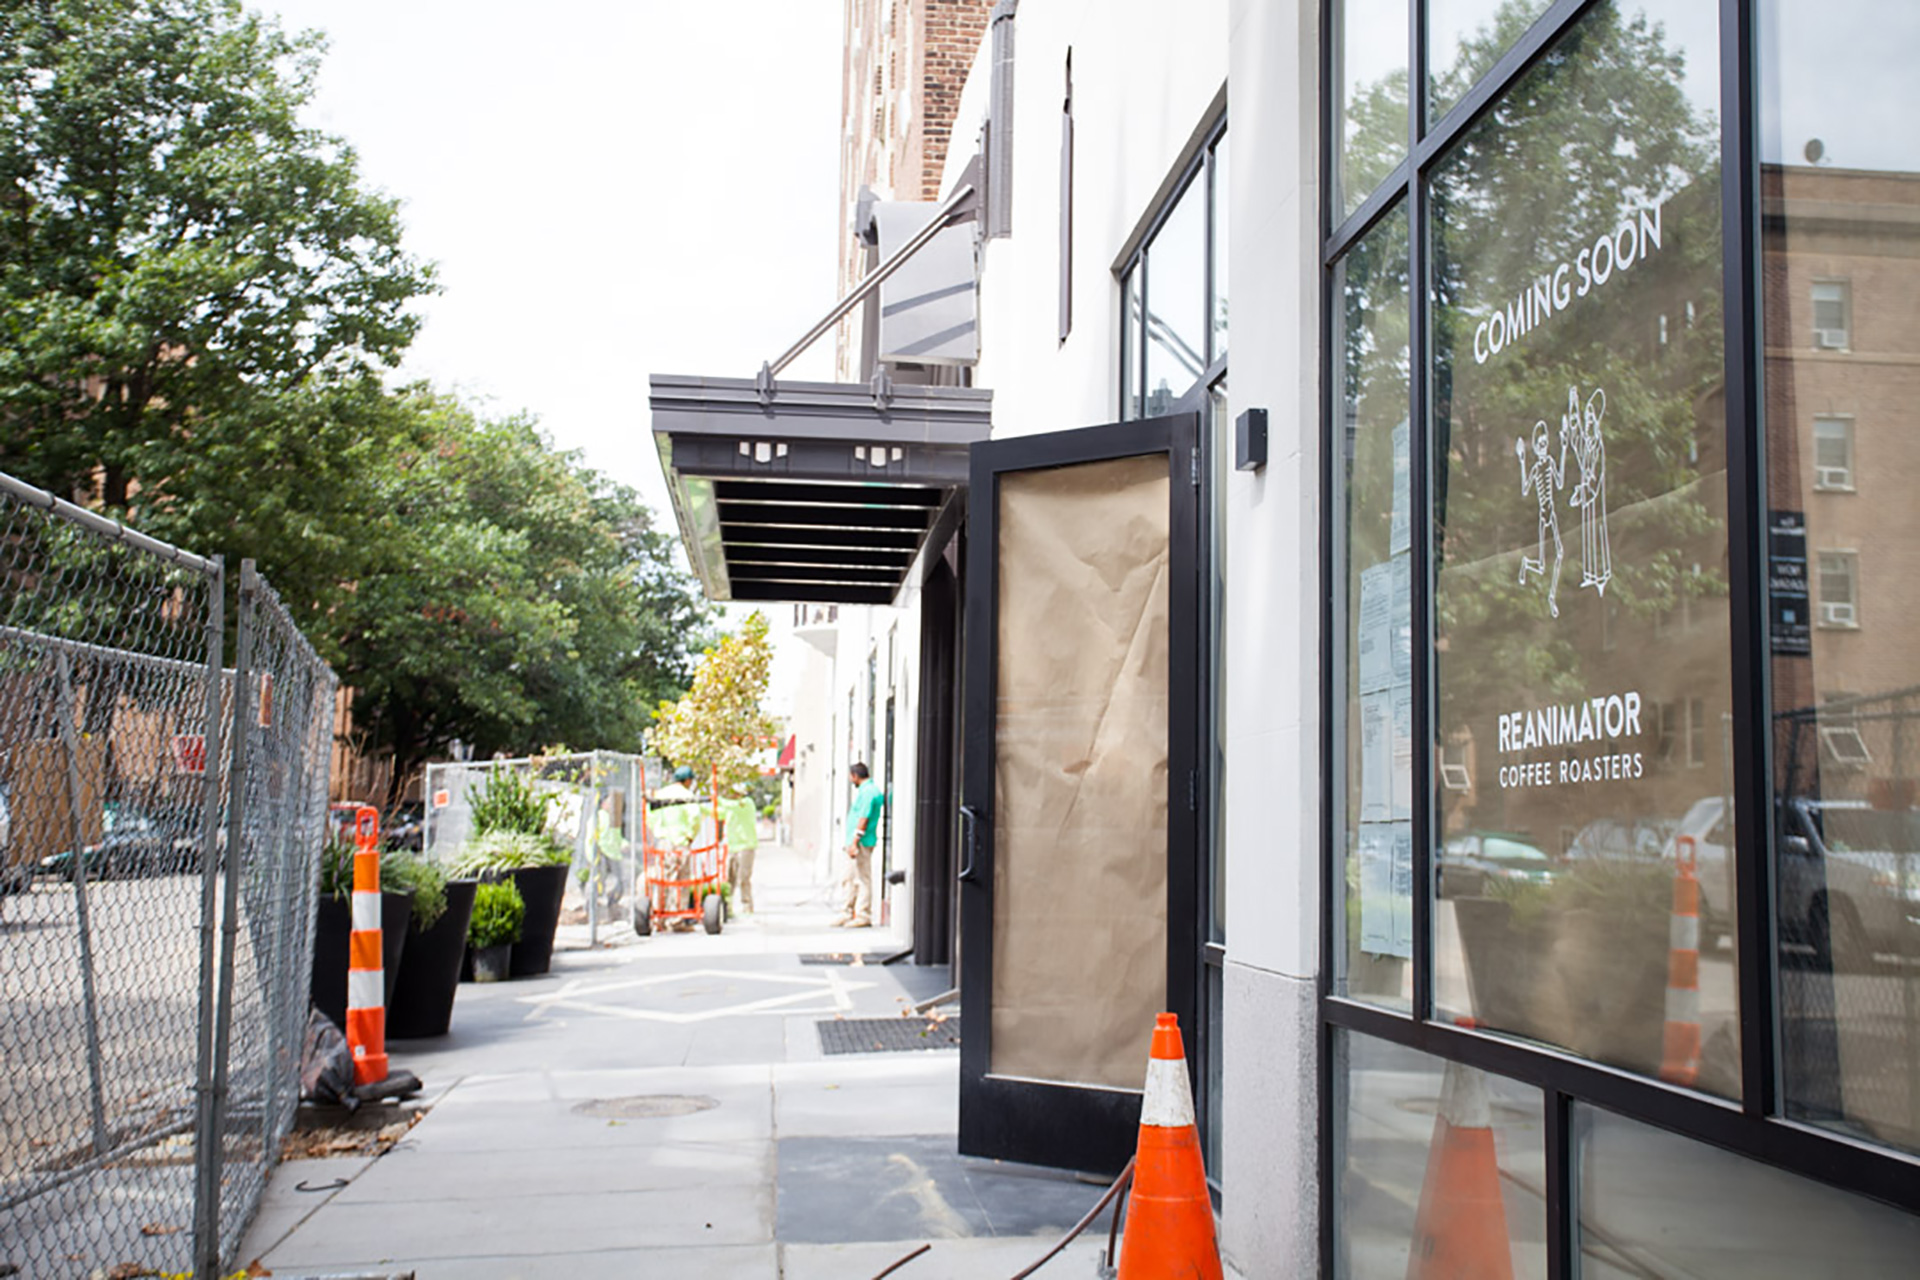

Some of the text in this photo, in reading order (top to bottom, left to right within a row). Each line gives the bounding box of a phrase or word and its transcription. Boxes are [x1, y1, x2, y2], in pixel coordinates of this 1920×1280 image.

[1473, 202, 1662, 365] COMING SOON
[1498, 691, 1642, 753] REANIMATOR
[1499, 752, 1643, 788] COFFEE ROASTERS
